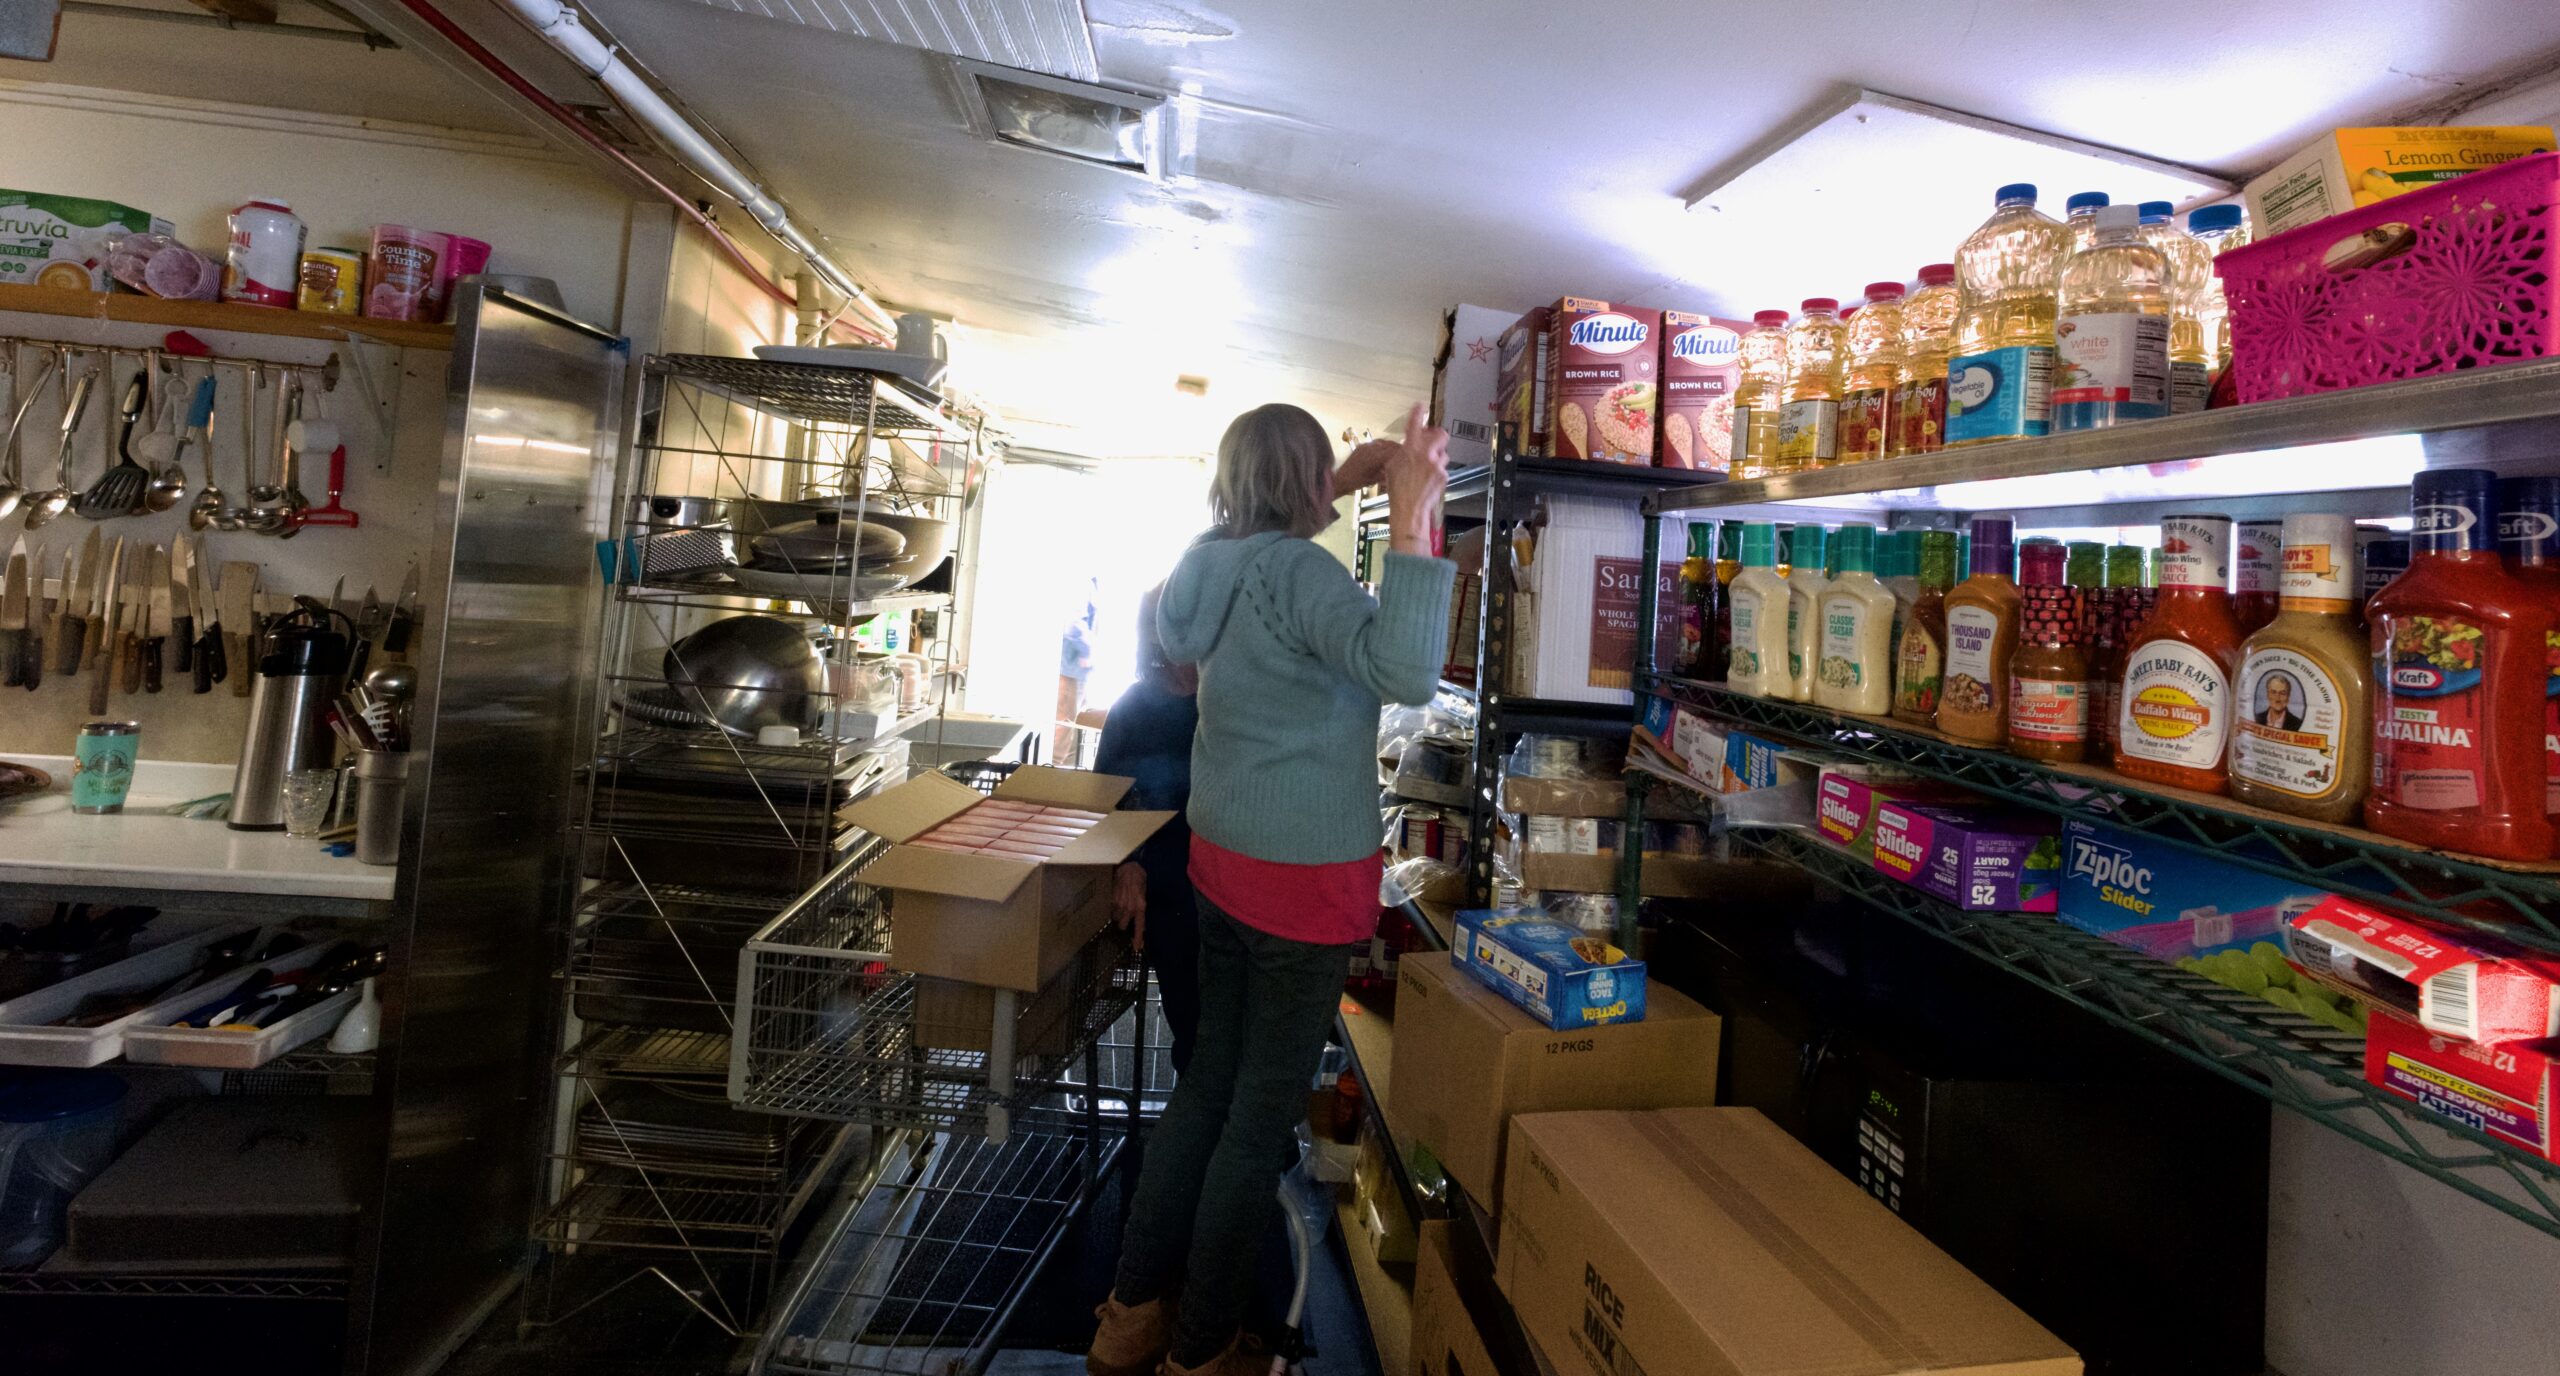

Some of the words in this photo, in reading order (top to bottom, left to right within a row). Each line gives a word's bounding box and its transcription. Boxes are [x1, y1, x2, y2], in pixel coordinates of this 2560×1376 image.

[2384, 149, 2455, 166] Lemon
[2460, 148, 2525, 165] Ginger
[2433, 170, 2471, 180] HERBA
[2262, 184, 2289, 202] Nutrition
[2289, 172, 2308, 186] Facts
[2266, 206, 2293, 224] Calories
[377, 244, 432, 264] Country
[385, 254, 422, 269] Time
[1571, 320, 1647, 344] Minute
[1674, 334, 1739, 356] Minut
[2070, 335, 2110, 349] white
[1565, 370, 1598, 379] BROWN
[1600, 370, 1620, 378] RICE
[1669, 381, 1701, 390] BROWN
[1703, 381, 1722, 389] RICE
[1974, 389, 1986, 399] Oil
[1915, 386, 1938, 403] Boy
[1860, 395, 1882, 412] Boy
[2166, 522, 2189, 532] BABY
[2414, 510, 2452, 528] raft
[2499, 518, 2534, 535] aft
[2241, 528, 2259, 538] ABY
[2180, 554, 2202, 565] Wing
[2251, 561, 2273, 572] Wing
[2291, 562, 2313, 570] SAUCE
[1600, 565, 1673, 593] Saa
[2162, 573, 2189, 583] SAUCE
[2290, 578, 2312, 588] 1969
[1599, 609, 1636, 620] WHOLE
[1828, 613, 1855, 626] CLASSIC
[1828, 625, 1854, 637] CAESAR
[1951, 623, 1991, 640] THOUSAND
[1955, 637, 1982, 652] ISLAND
[2129, 660, 2153, 685] SWEET
[2155, 658, 2185, 672] BABY
[2184, 664, 2219, 693] RAY'S
[2398, 671, 2430, 684] Kraft
[2314, 677, 2332, 704] FLAVOR
[2134, 703, 2169, 718] Buffalo
[2171, 707, 2203, 725] Wing
[2399, 709, 2429, 721] ZESTY
[2161, 721, 2186, 732] SAUCE
[2376, 720, 2472, 748] CATALINA
[2263, 729, 2291, 742] SPECIAL
[2293, 734, 2322, 746] SAUCE
[1759, 745, 1769, 788] Double
[1822, 796, 1861, 829] Slider
[1822, 815, 1854, 841] Storage
[1876, 825, 1924, 862] Slider
[1875, 846, 1912, 873] Freezer
[1942, 846, 1959, 866] 25
[1973, 857, 2010, 866] QUART
[1973, 870, 1989, 878] Bags
[1989, 870, 2015, 879] Freezer
[2074, 841, 2152, 895] Ziploc
[1934, 872, 1957, 887] QUART
[1971, 885, 1997, 906] 25
[2100, 884, 2156, 916] Slider
[2414, 945, 2443, 959] 12
[1588, 979, 1615, 991] DINNER
[1595, 972, 1607, 981] KIT
[1589, 987, 1615, 1000] TACO
[1581, 1000, 1627, 1022] ORTEGA
[1545, 1043, 1559, 1055] 12
[1561, 1039, 1594, 1053] PKGS
[2458, 1047, 2493, 1066] SLIDER
[2493, 1050, 2517, 1074] 12
[2393, 1069, 2444, 1095] SLIDER
[2406, 1063, 2447, 1084] GALLON
[2449, 1080, 2466, 1091] 2.5
[2467, 1087, 2508, 1110] JUMBO
[2421, 1092, 2482, 1130] Hefty
[2445, 1089, 2518, 1126] STORAGE
[1585, 1259, 1625, 1331] RICE
[1584, 1303, 1616, 1368] MIX
